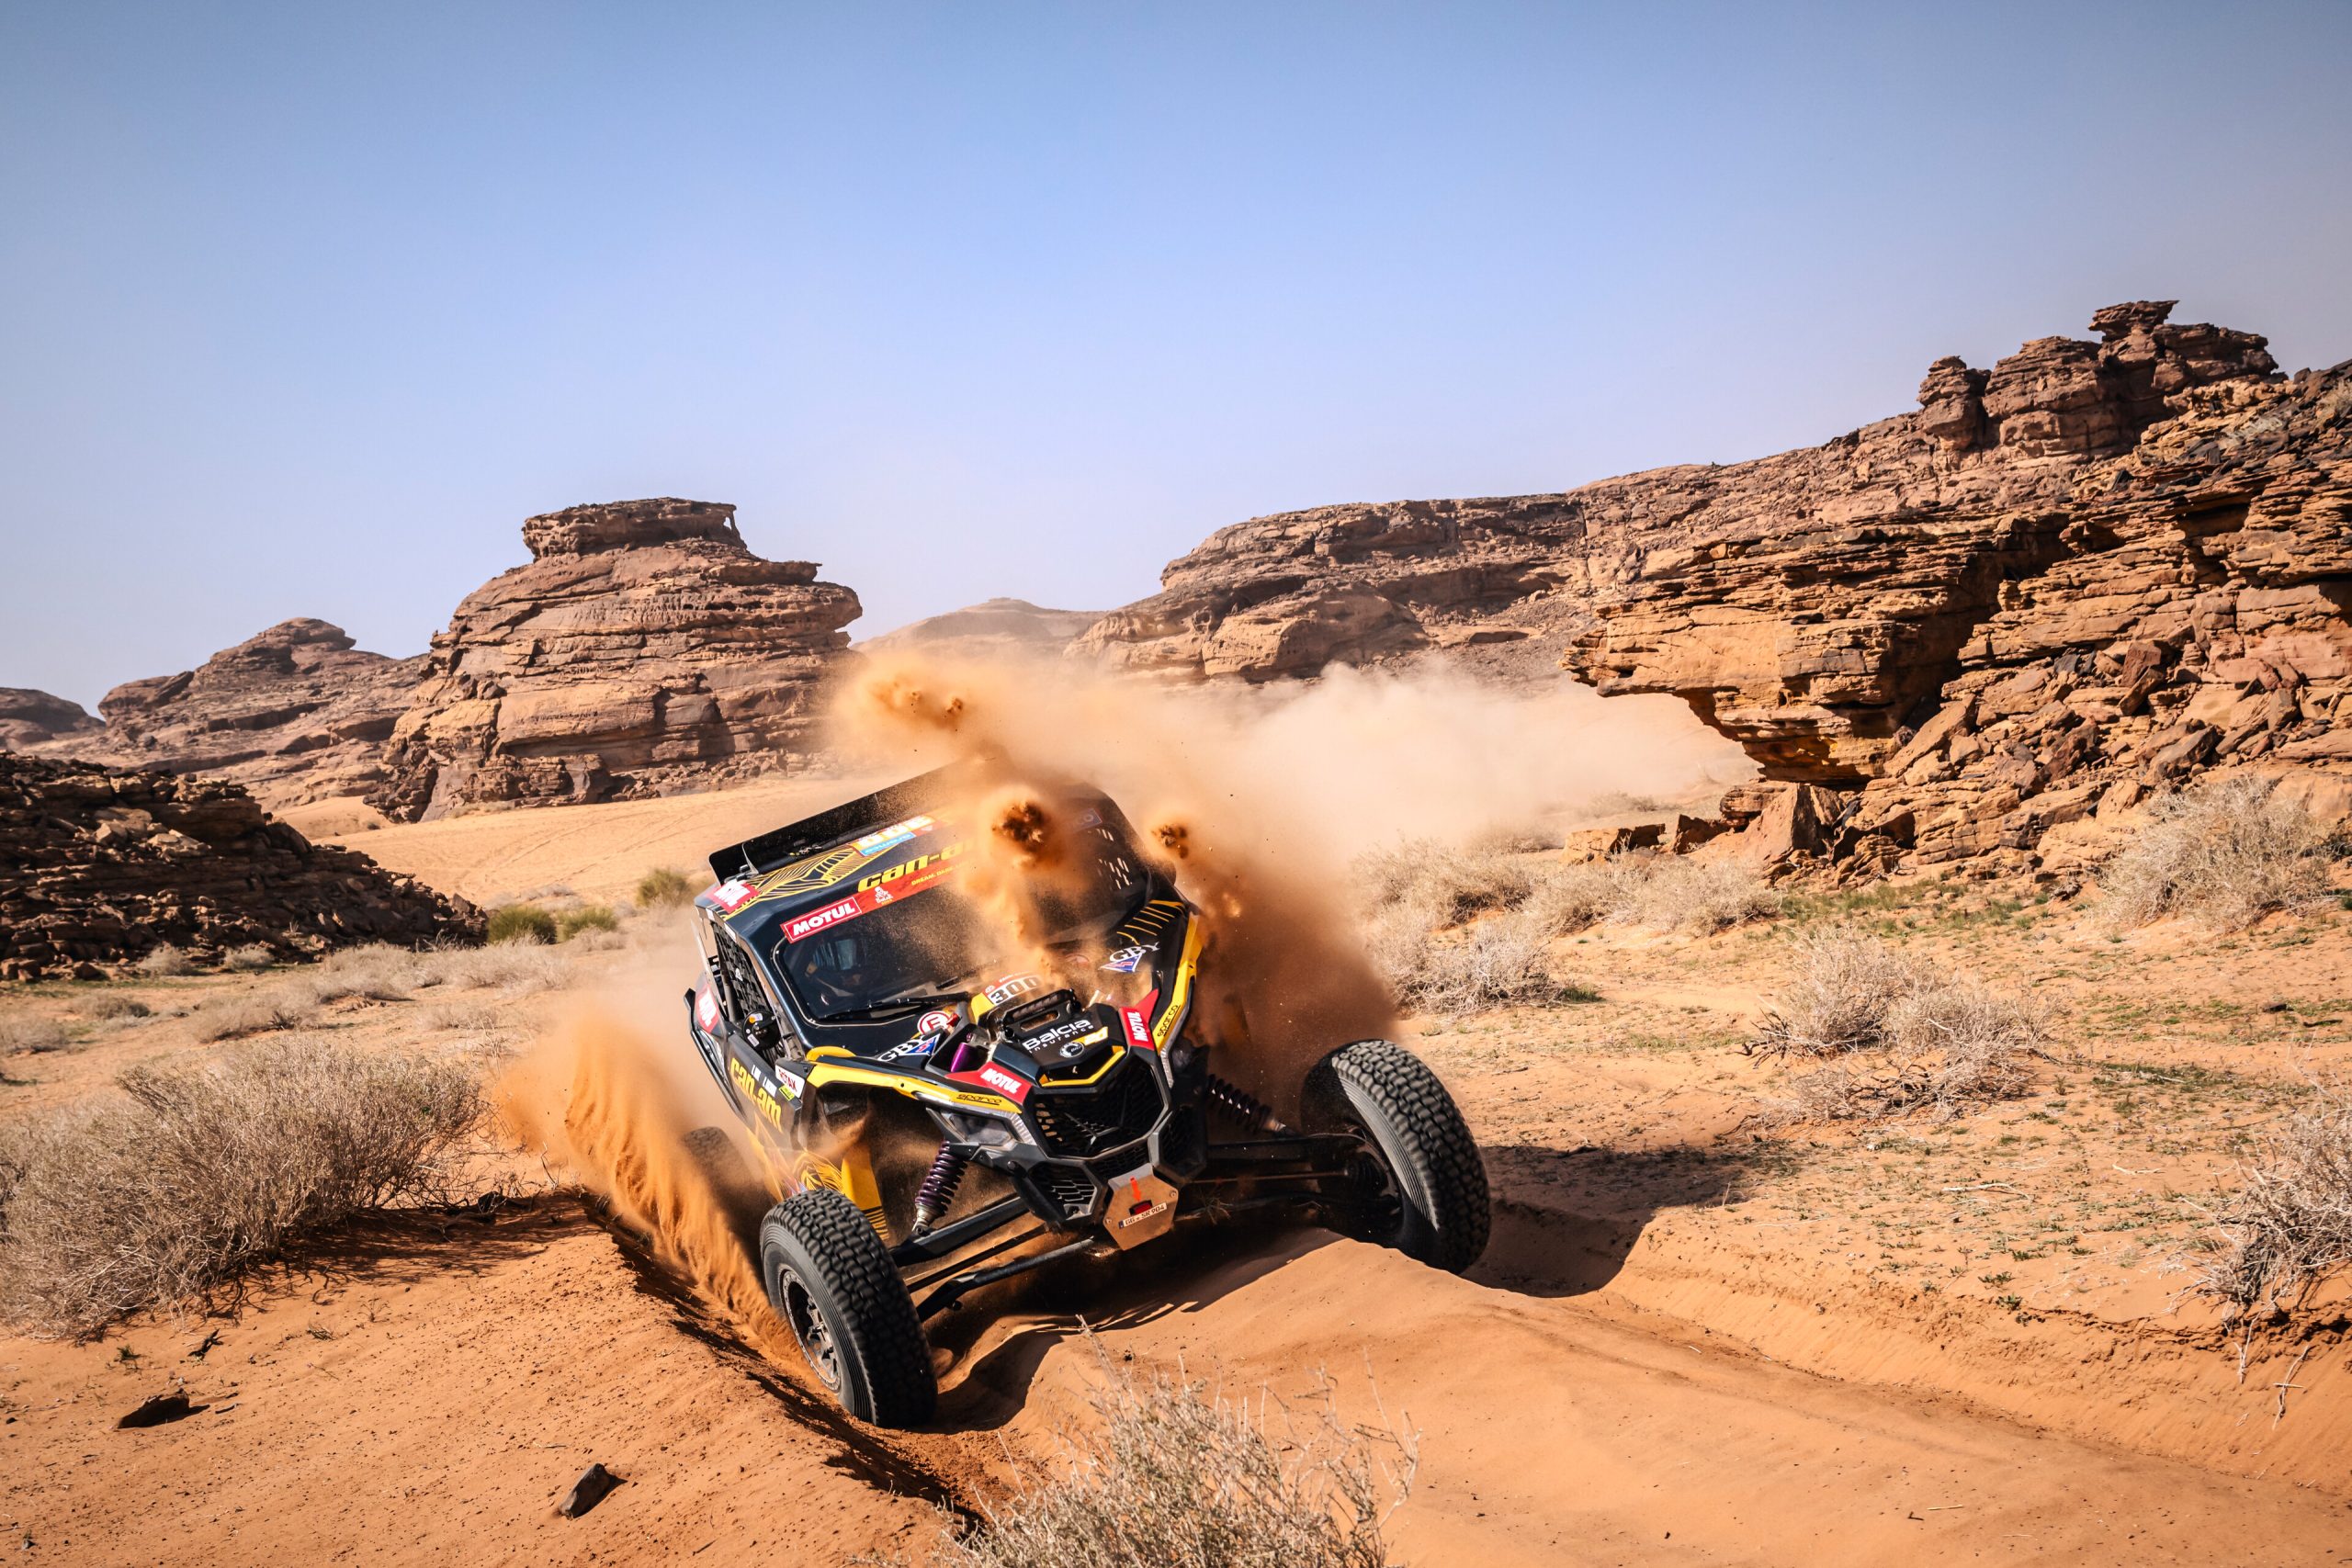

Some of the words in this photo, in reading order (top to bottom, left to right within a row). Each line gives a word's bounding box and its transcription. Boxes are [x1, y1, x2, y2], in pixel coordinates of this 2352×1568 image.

[857, 840, 976, 891] can-a
[793, 903, 855, 936] MOTUL
[1109, 942, 1159, 963] GBY
[990, 976, 1041, 1004] 300
[1022, 1020, 1091, 1052] Balcia
[1126, 1011, 1148, 1042] MOTUL
[1158, 1004, 1181, 1038] sparco
[730, 1057, 784, 1133] can-am
[979, 1067, 1022, 1094] MOTUL
[956, 1093, 1002, 1105] sparco
